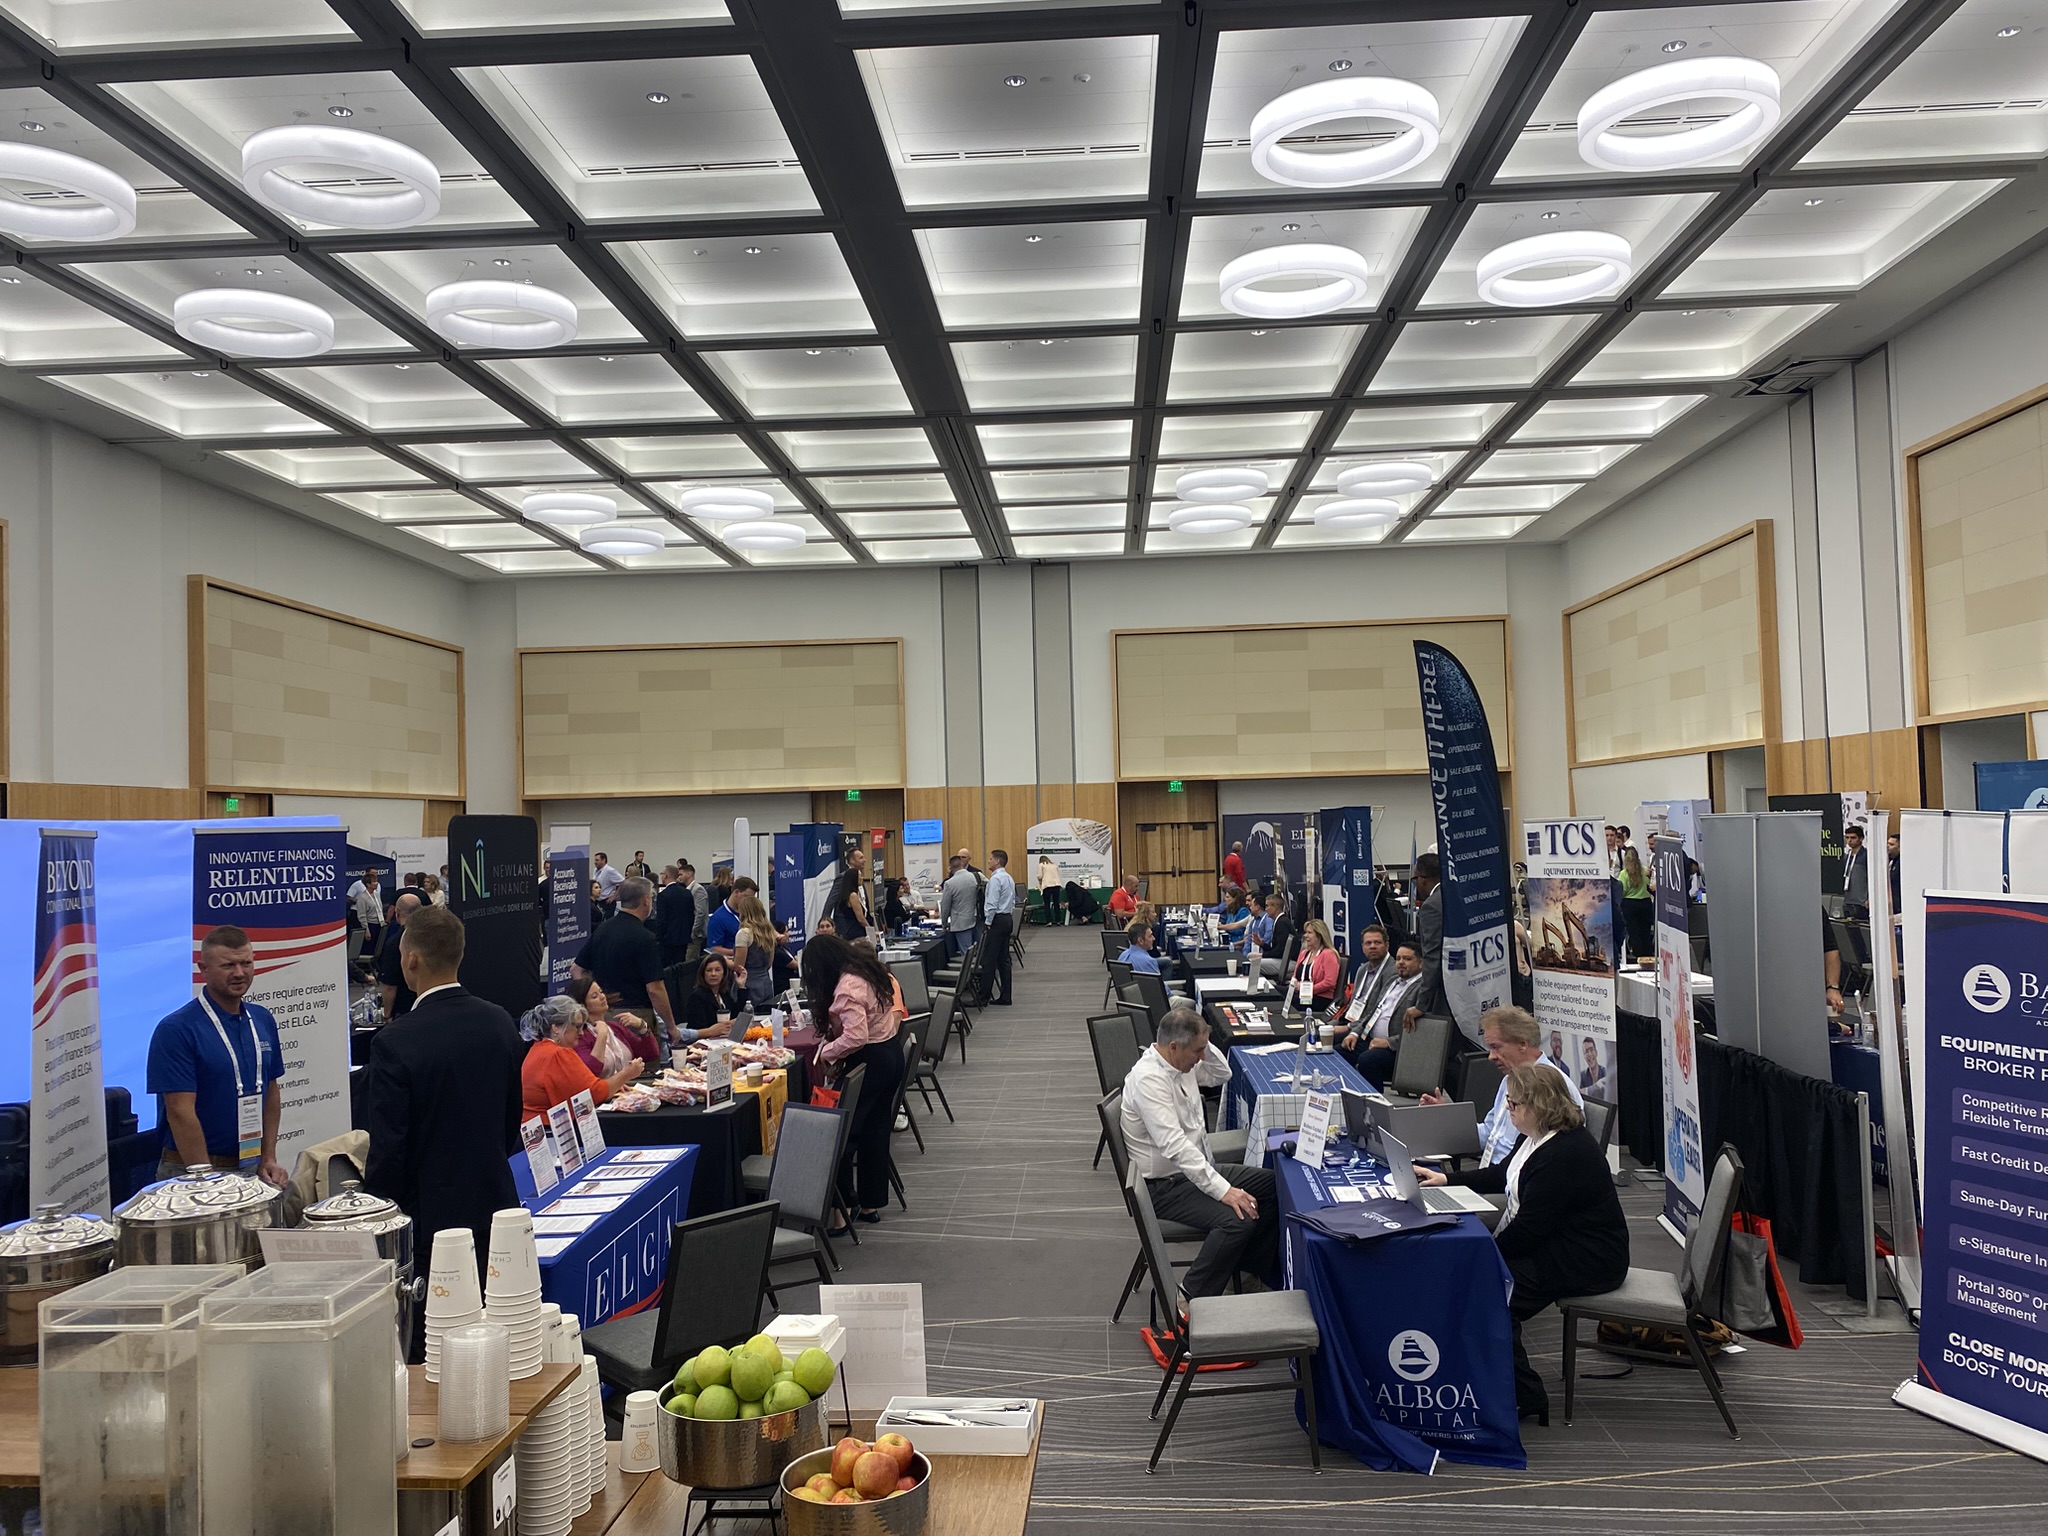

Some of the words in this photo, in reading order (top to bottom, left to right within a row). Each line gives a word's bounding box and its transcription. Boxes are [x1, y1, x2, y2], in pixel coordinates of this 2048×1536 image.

[1420, 651, 1445, 731] HERE!
[1427, 734, 1446, 760] IT
[1545, 823, 1595, 856] TCS
[209, 850, 276, 864] INNOVATIVE
[278, 848, 337, 862] FINANCING.
[46, 860, 94, 893] BEYOND
[209, 865, 335, 888] RELENTLESS
[492, 863, 534, 878] NEWLANE
[553, 868, 575, 879] Accounts
[780, 870, 802, 878] NEWITY
[1543, 867, 1574, 877] EQUIPMENT
[1575, 868, 1600, 876] FINANCE
[1664, 852, 1681, 892] TCS
[493, 881, 530, 897] FINANCE
[553, 880, 578, 891] Receivable
[208, 886, 337, 909] COMMITMENT.
[553, 891, 576, 904] Financing
[463, 908, 486, 920] BUSINESS
[486, 906, 507, 917] LENDING
[507, 904, 521, 913] DONE
[521, 902, 534, 911] RIGHT
[788, 917, 796, 928] #1
[1470, 933, 1504, 968] TCS
[273, 986, 304, 1001] require
[305, 982, 336, 995] creative
[1540, 991, 1561, 1004] options
[1561, 994, 1582, 1005] tailored
[1583, 997, 1589, 1006] to
[1590, 999, 1600, 1007] our
[1553, 981, 1582, 993] equipment
[1582, 983, 1608, 998] financing
[287, 1001, 304, 1013] and
[306, 1003, 312, 1011] a
[313, 999, 329, 1010] way
[1560, 1006, 1577, 1018] needs,
[1578, 1010, 1611, 1023] competitive
[292, 1015, 318, 1027] ELGA.
[1550, 1016, 1560, 1027] and
[1561, 1018, 1591, 1033] transparent
[1592, 1024, 1609, 1034] terms
[1940, 1035, 2048, 1062] EQUIPMENT
[1963, 1056, 2036, 1080] BROKER
[286, 1077, 309, 1090] returns
[304, 1094, 318, 1105] with
[319, 1090, 340, 1102] unique
[1962, 1094, 2037, 1119] Competitive
[1962, 1110, 2010, 1129] Flexible
[1961, 1146, 1988, 1162] Fast
[1991, 1152, 2030, 1171] Credit
[1960, 1190, 2024, 1217] Same-Day
[1959, 1236, 2031, 1263] e-Signature
[594, 1215, 672, 1322] ELGA
[1958, 1275, 1994, 1295] Portal
[1957, 1290, 2037, 1324] Management
[1948, 1332, 2004, 1362] CLOSE
[1943, 1348, 2000, 1379] BOOST
[1421, 1431, 1452, 1440] AMERIS
[1453, 1433, 1476, 1441] BANK
